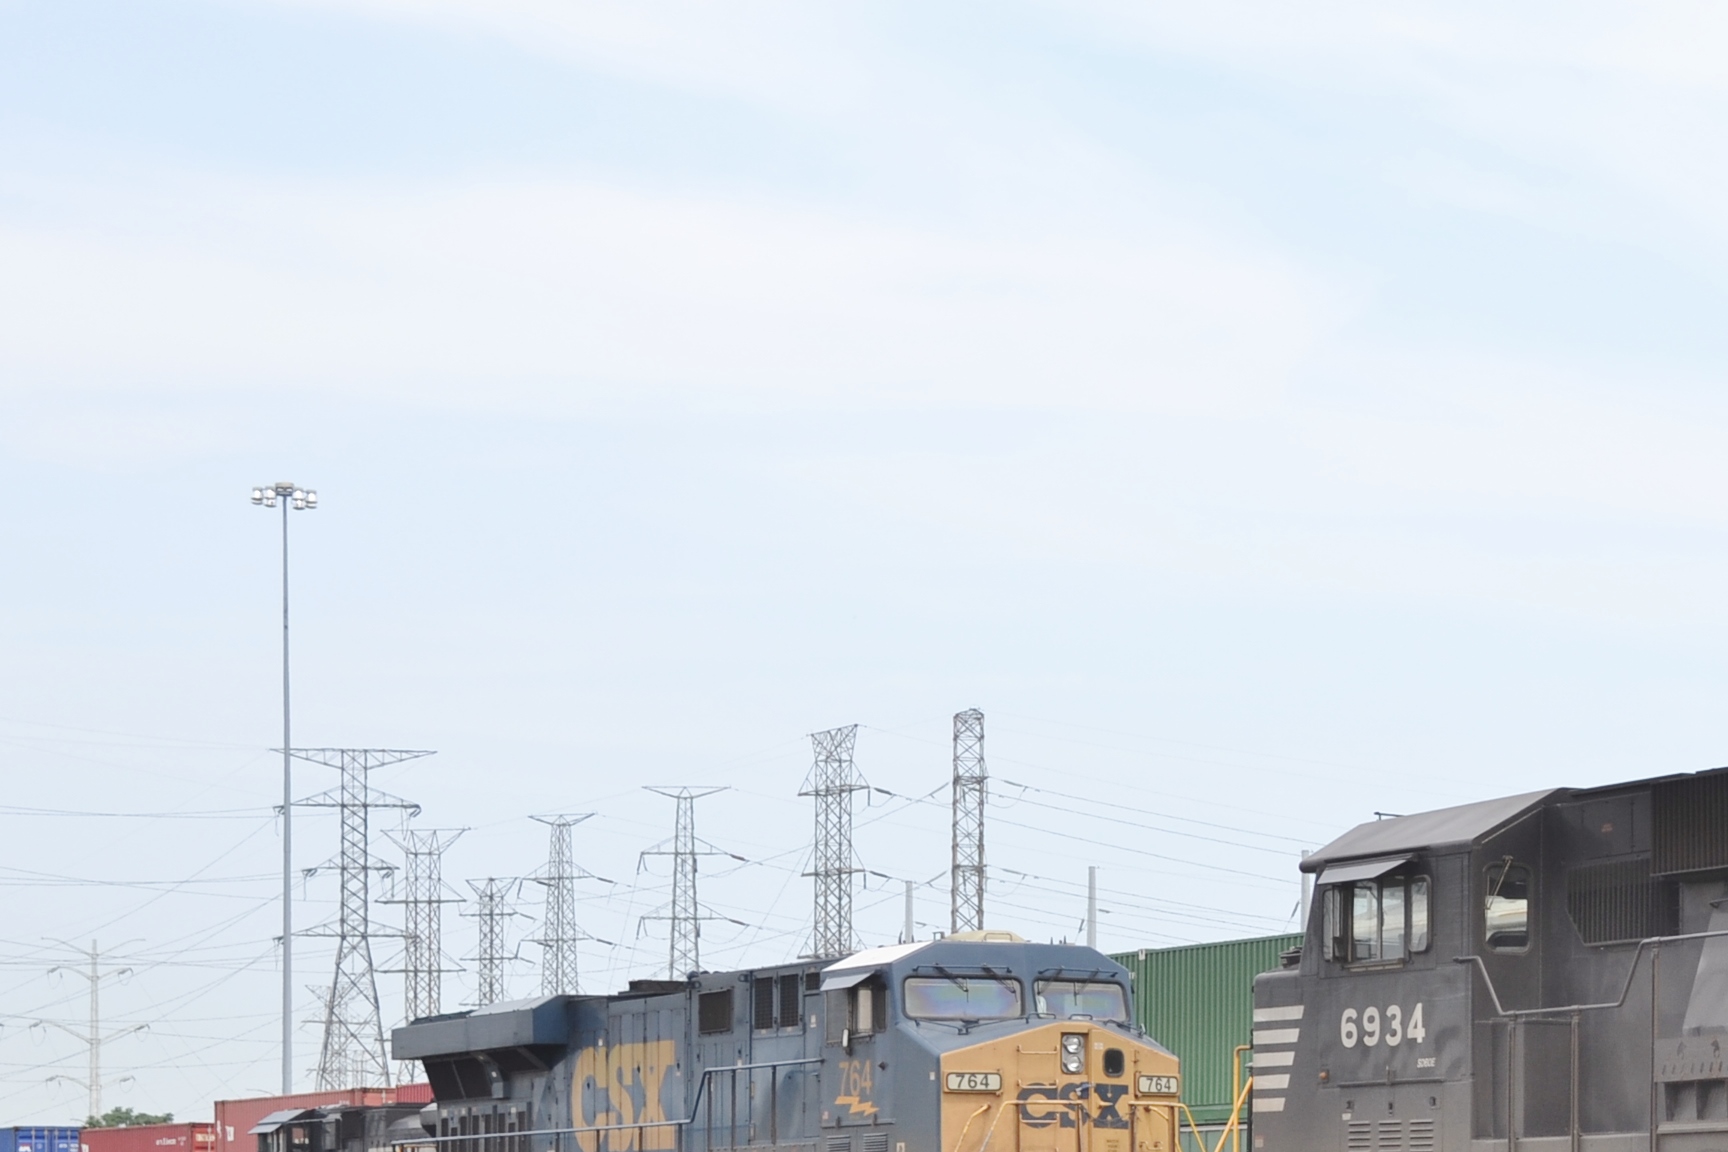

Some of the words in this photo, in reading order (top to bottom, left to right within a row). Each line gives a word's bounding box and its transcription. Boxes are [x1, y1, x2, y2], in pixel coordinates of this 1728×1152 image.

[1340, 1003, 1425, 1048] 6934
[838, 1060, 873, 1096] 764
[955, 1073, 990, 1089] 764
[1146, 1077, 1171, 1092] 764
[1016, 1082, 1129, 1129] CSX
